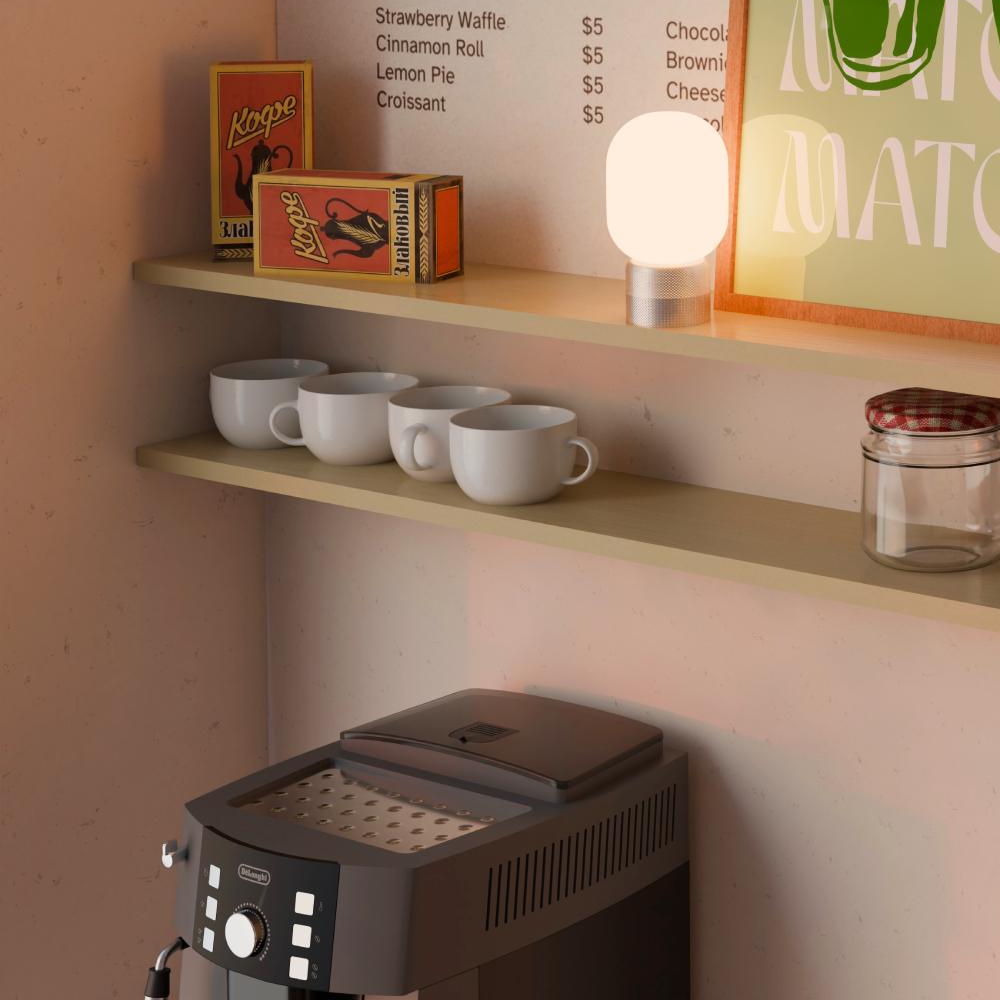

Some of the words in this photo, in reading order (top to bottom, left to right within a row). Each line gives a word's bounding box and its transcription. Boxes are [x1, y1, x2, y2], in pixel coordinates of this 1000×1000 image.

[376, 7, 453, 31] Strawberry
[458, 11, 505, 30] Waffle
[582, 16, 603, 35] $5
[376, 34, 450, 55] Cinnamon
[456, 39, 484, 57] Roll
[583, 45, 603, 64] $5
[376, 62, 427, 84] Lemon
[432, 66, 455, 84] Pie
[666, 51, 727, 73] Browni
[583, 75, 603, 94] $5
[376, 90, 446, 113] Croissant
[583, 104, 603, 124] $5
